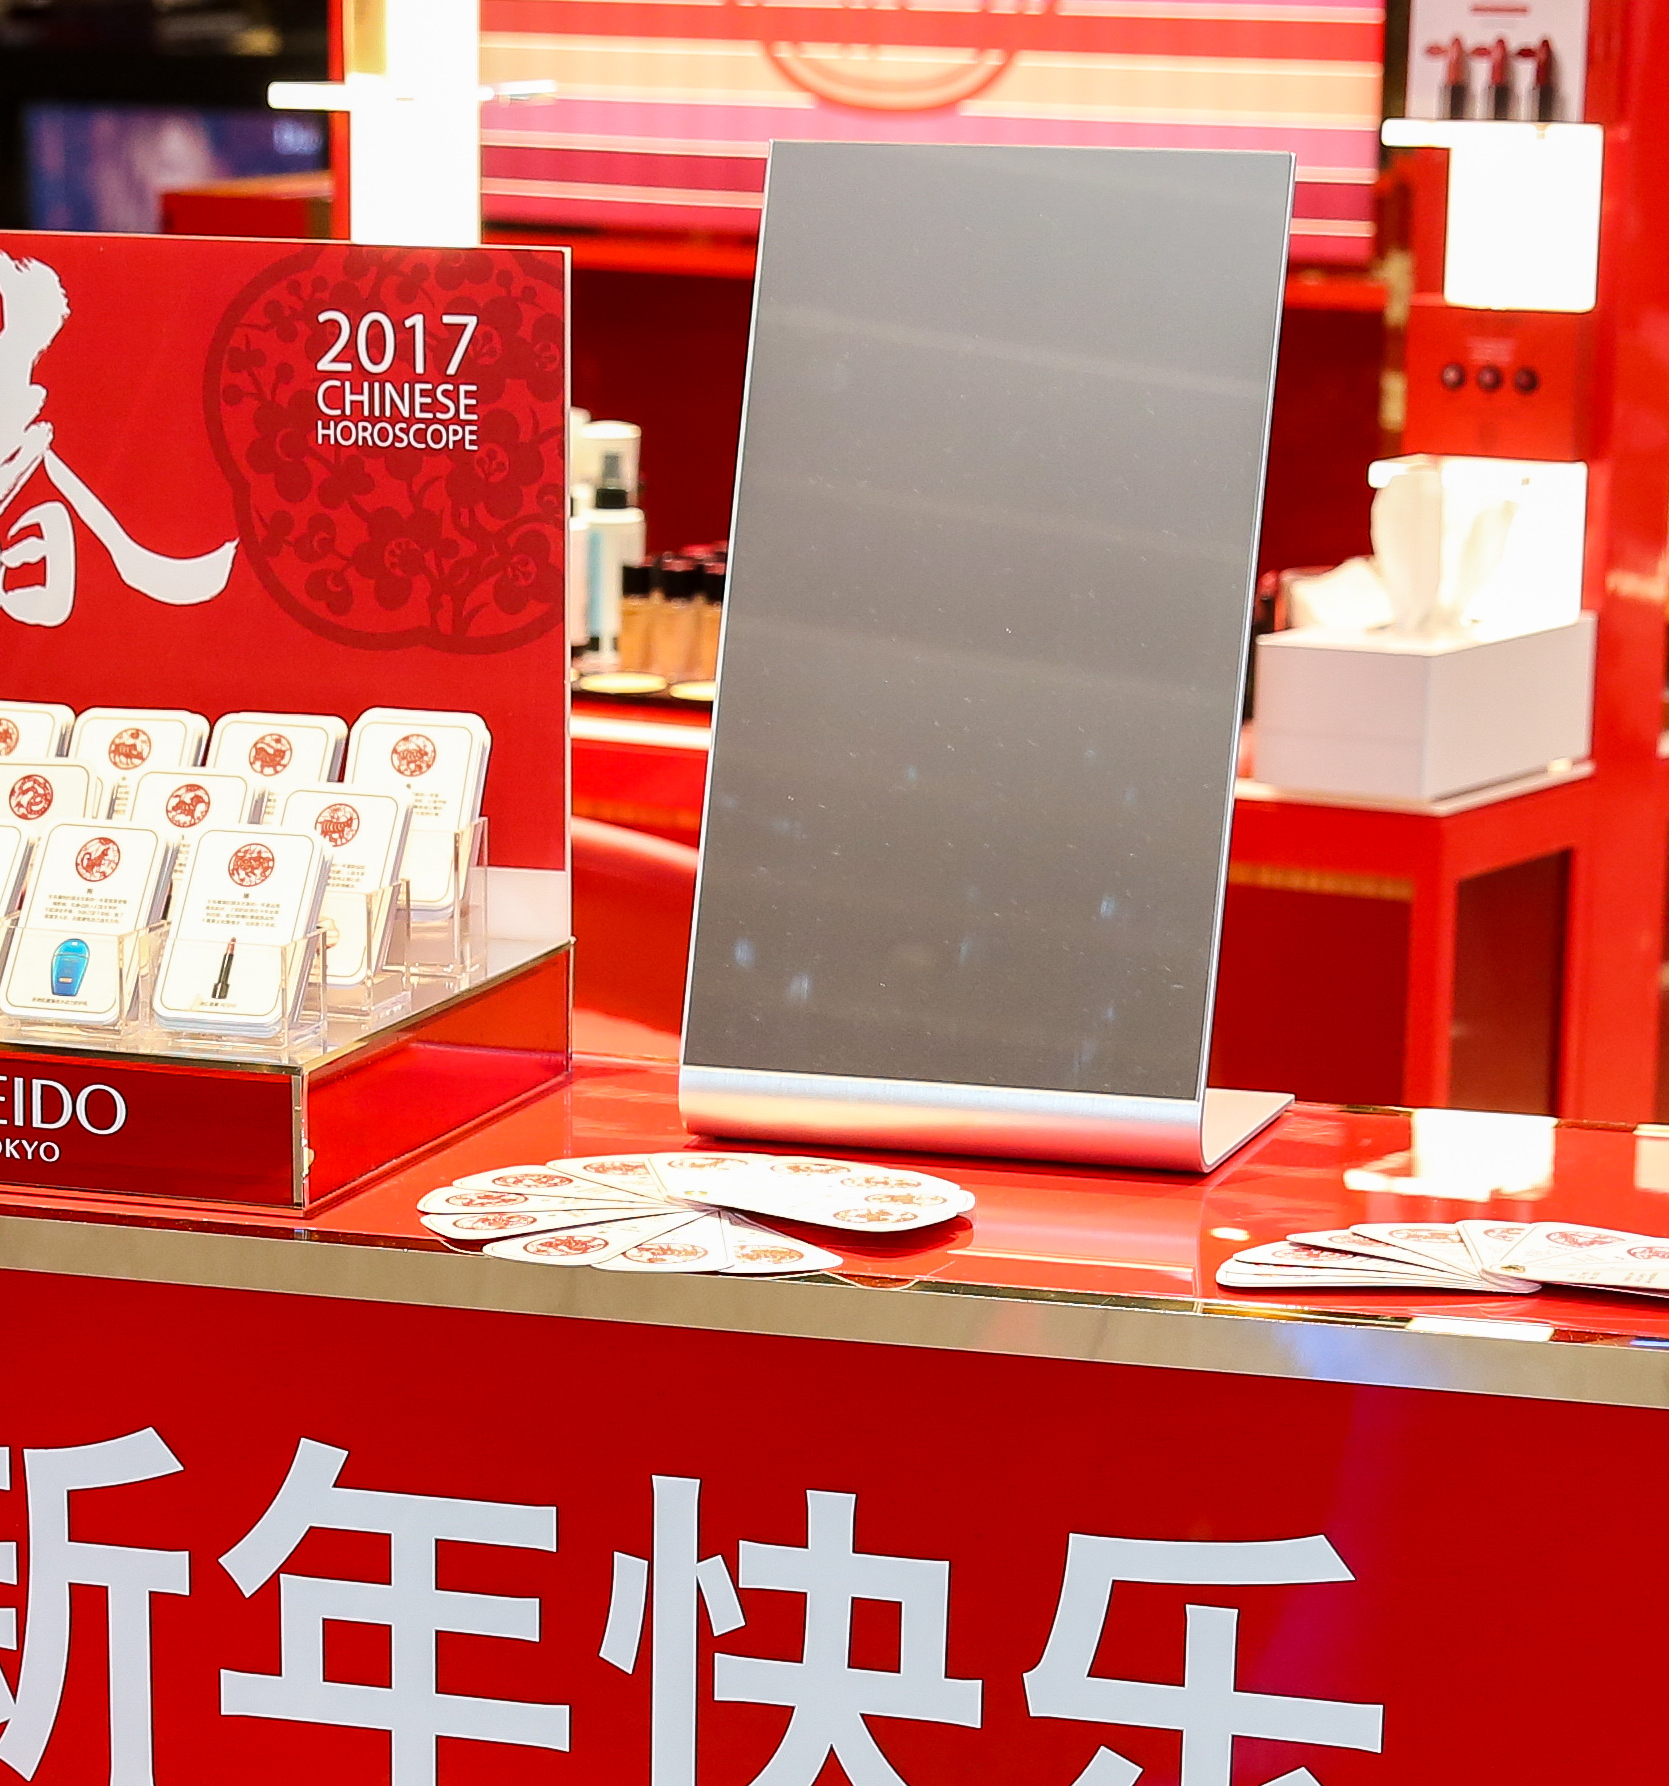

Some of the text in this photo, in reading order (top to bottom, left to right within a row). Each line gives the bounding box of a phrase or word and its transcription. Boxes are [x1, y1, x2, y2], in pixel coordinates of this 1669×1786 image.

[315, 310, 479, 376] 2017
[315, 380, 479, 421] CHINESE
[316, 420, 479, 451] HOROSCOPE
